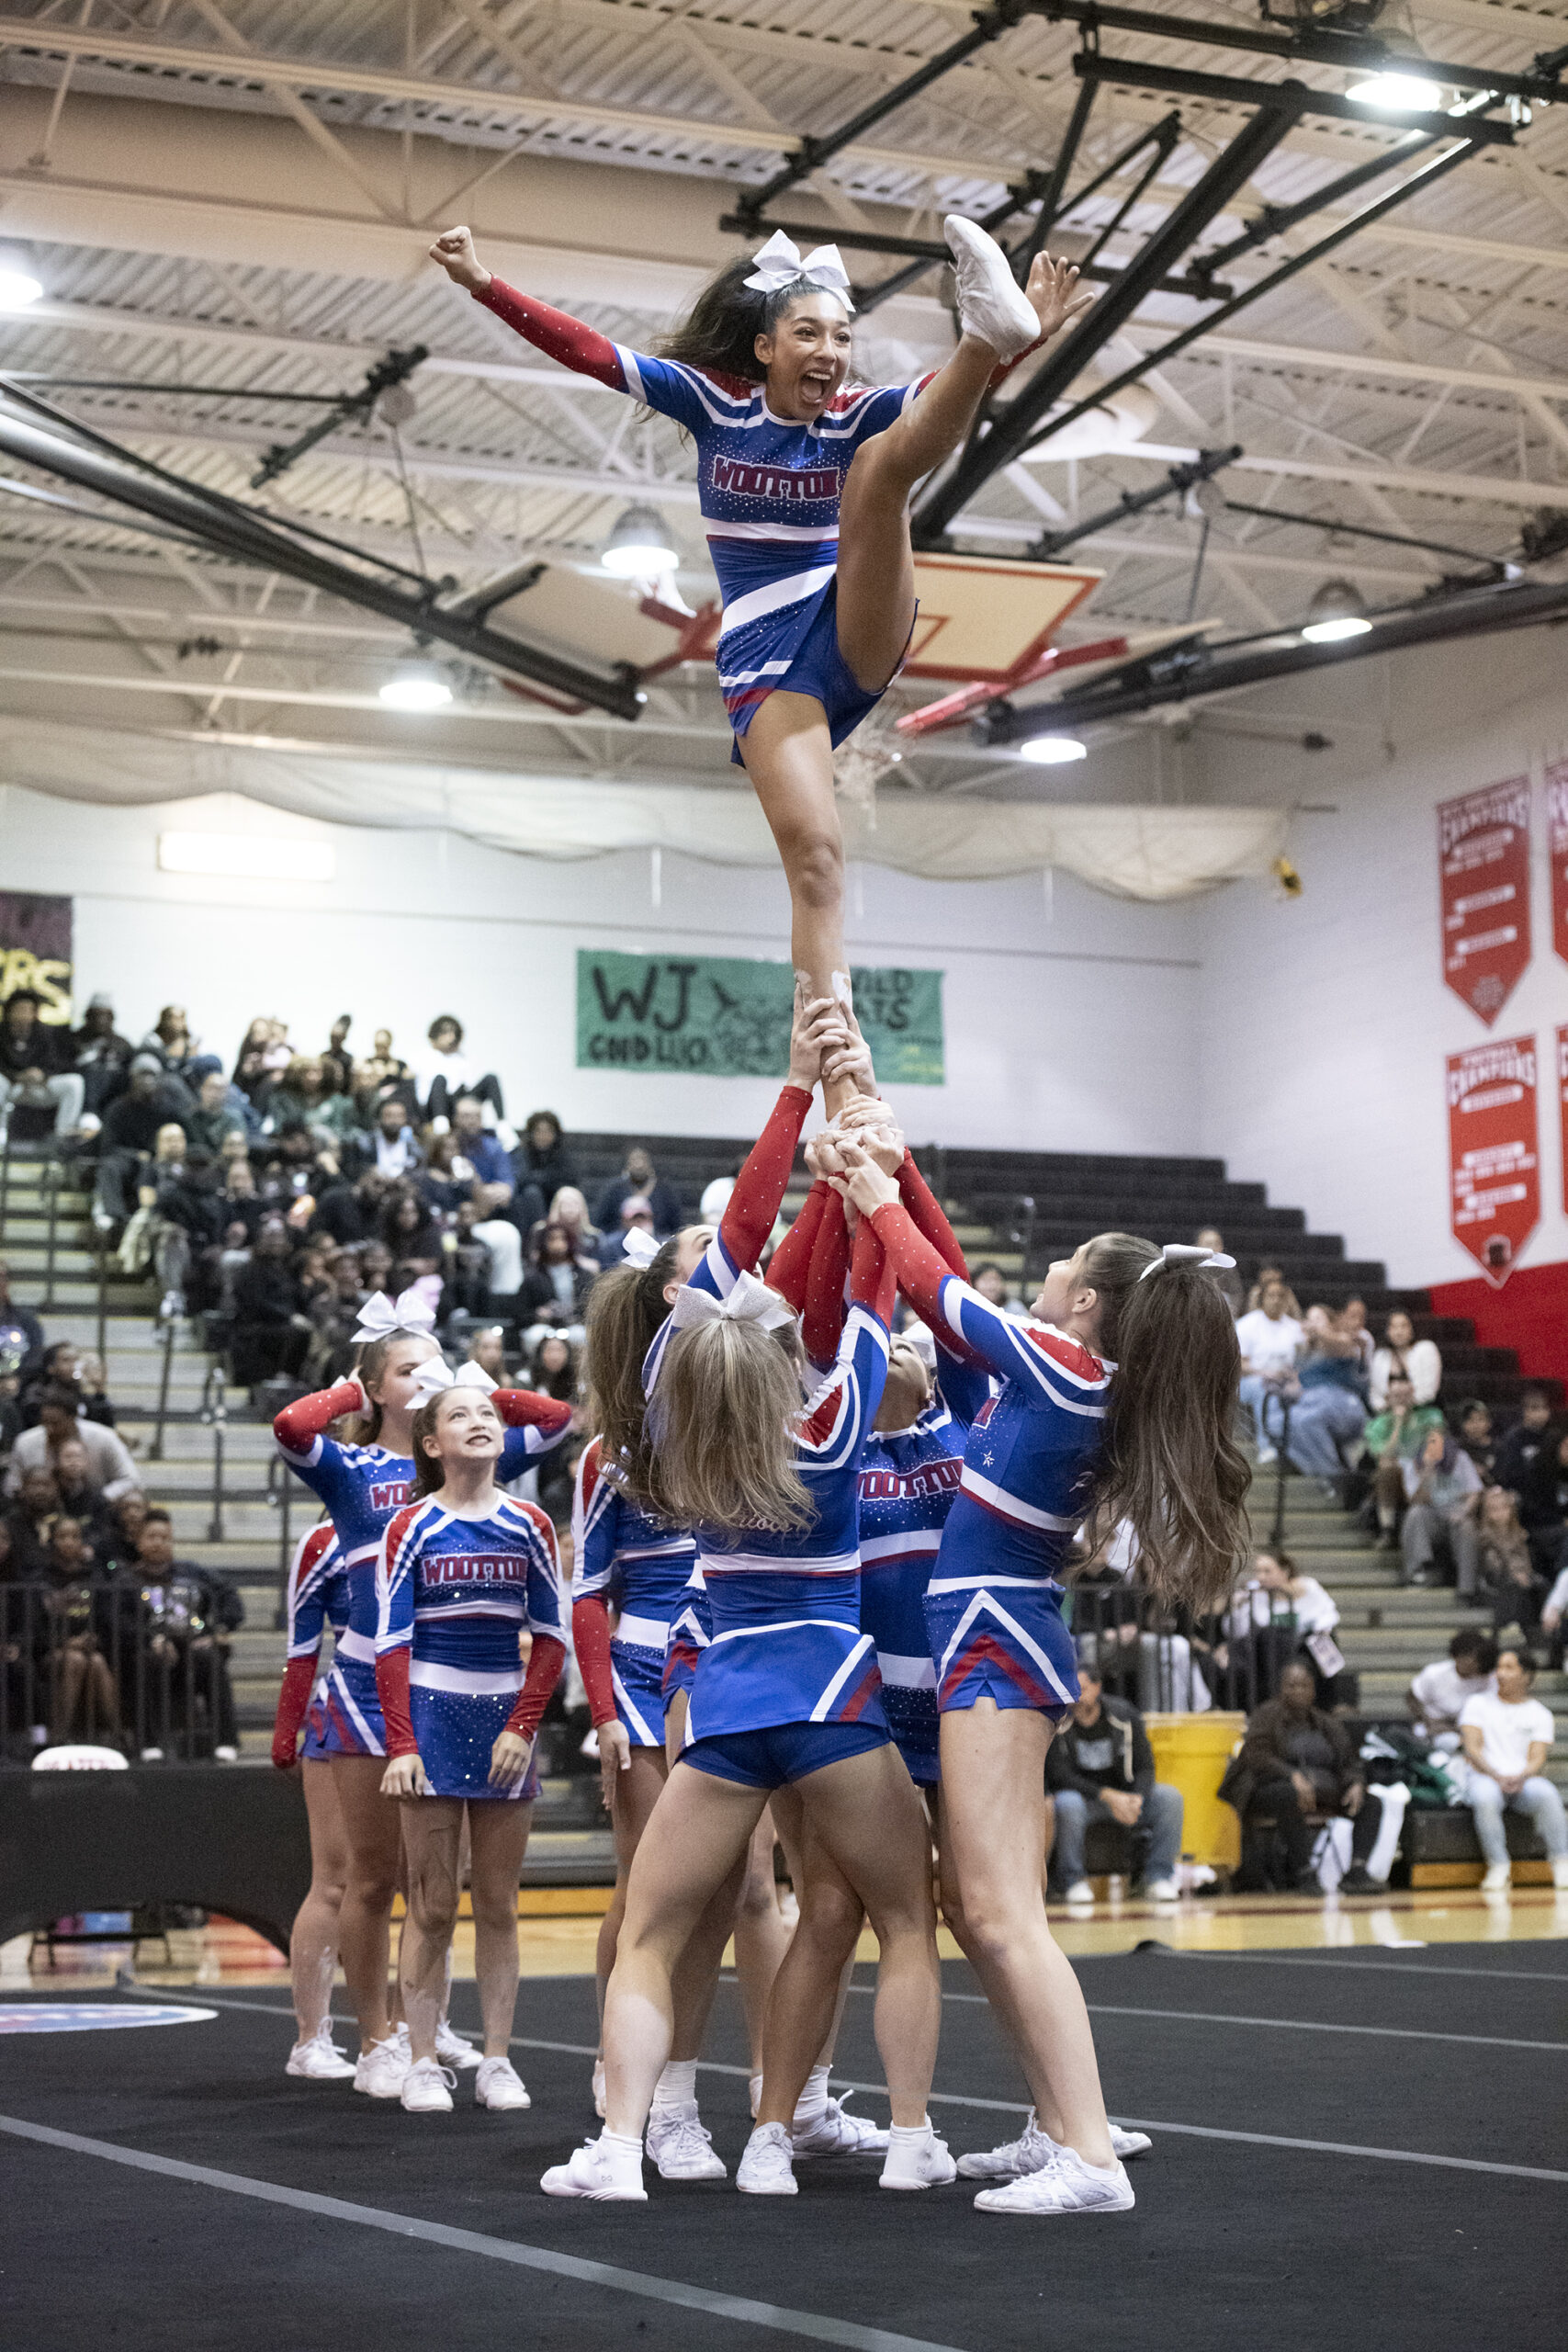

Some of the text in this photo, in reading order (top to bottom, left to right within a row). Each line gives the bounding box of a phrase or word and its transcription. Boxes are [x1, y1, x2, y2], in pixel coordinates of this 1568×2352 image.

[713, 454, 840, 502] WOOTTON
[592, 962, 698, 1032] WJ
[858, 1455, 964, 1501] OOTTO
